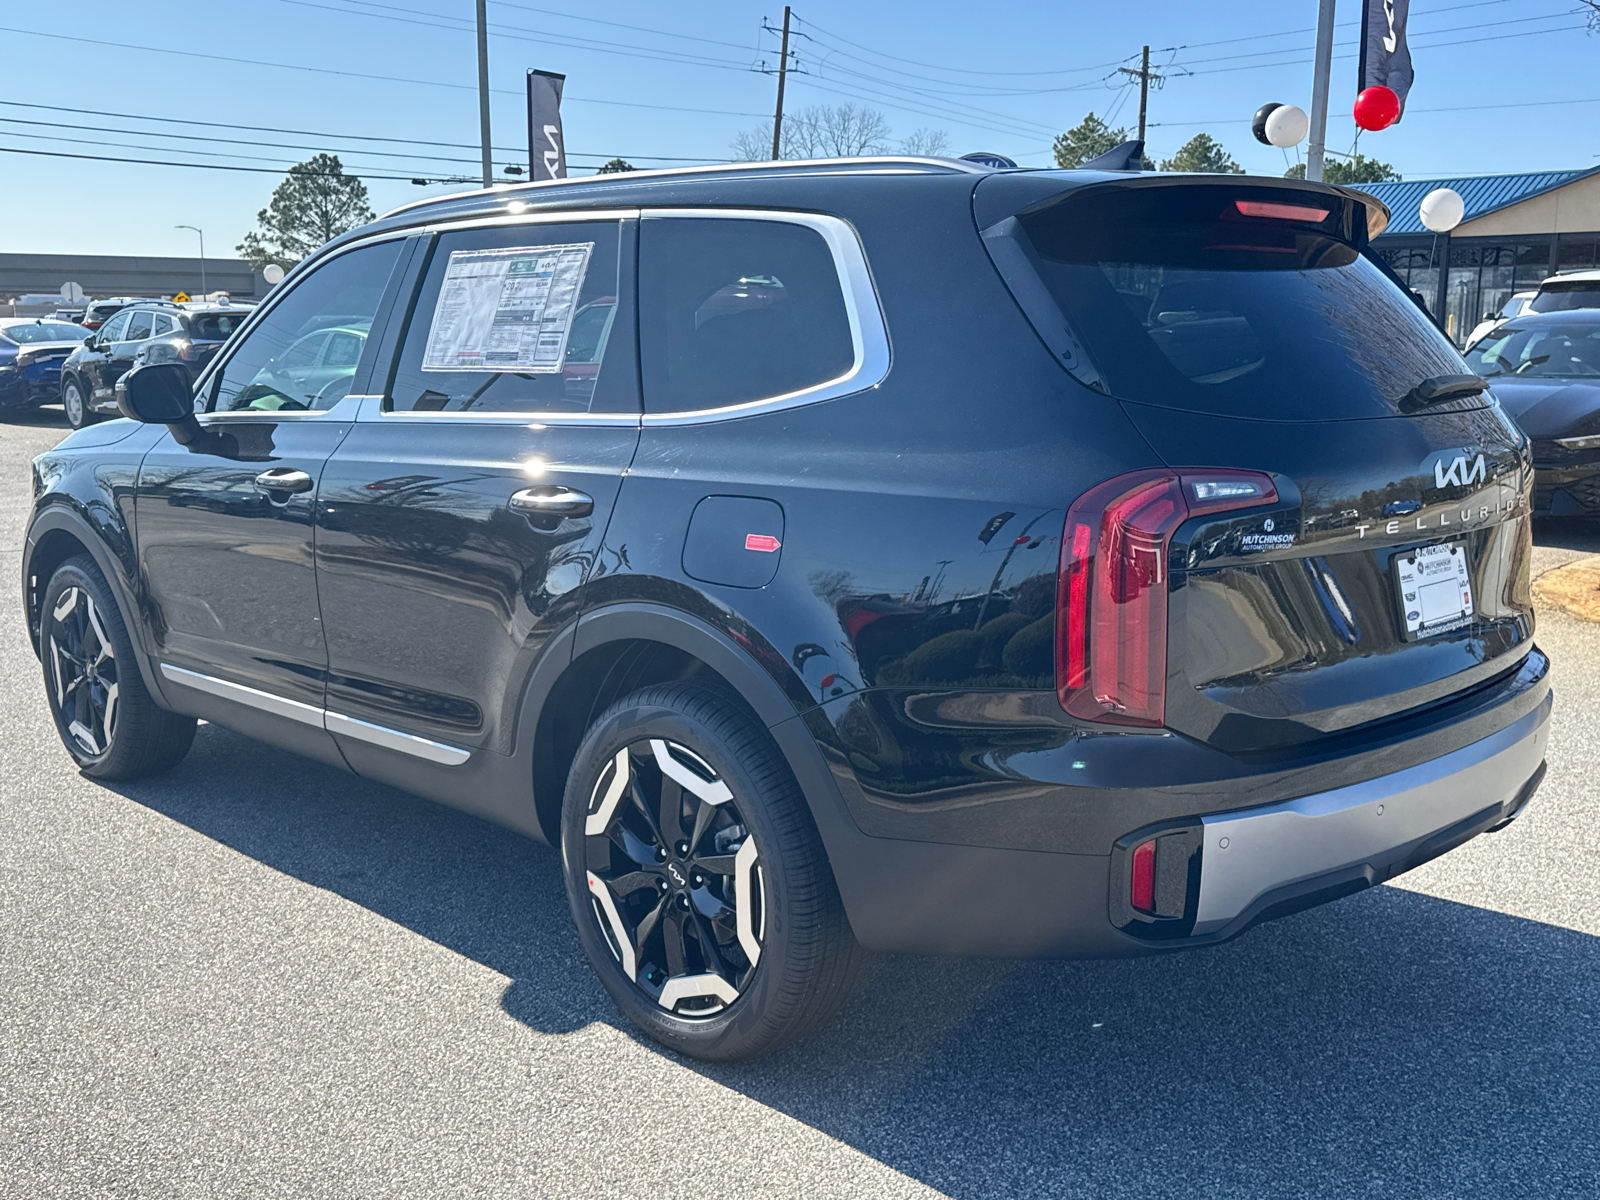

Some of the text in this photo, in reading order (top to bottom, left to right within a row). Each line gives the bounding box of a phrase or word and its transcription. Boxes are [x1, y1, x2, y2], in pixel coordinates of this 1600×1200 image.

[1355, 499, 1525, 539] TELLURIDE
[1241, 533, 1295, 545] HUTCHINSON
[1421, 543, 1453, 558] HUTCHINSON
